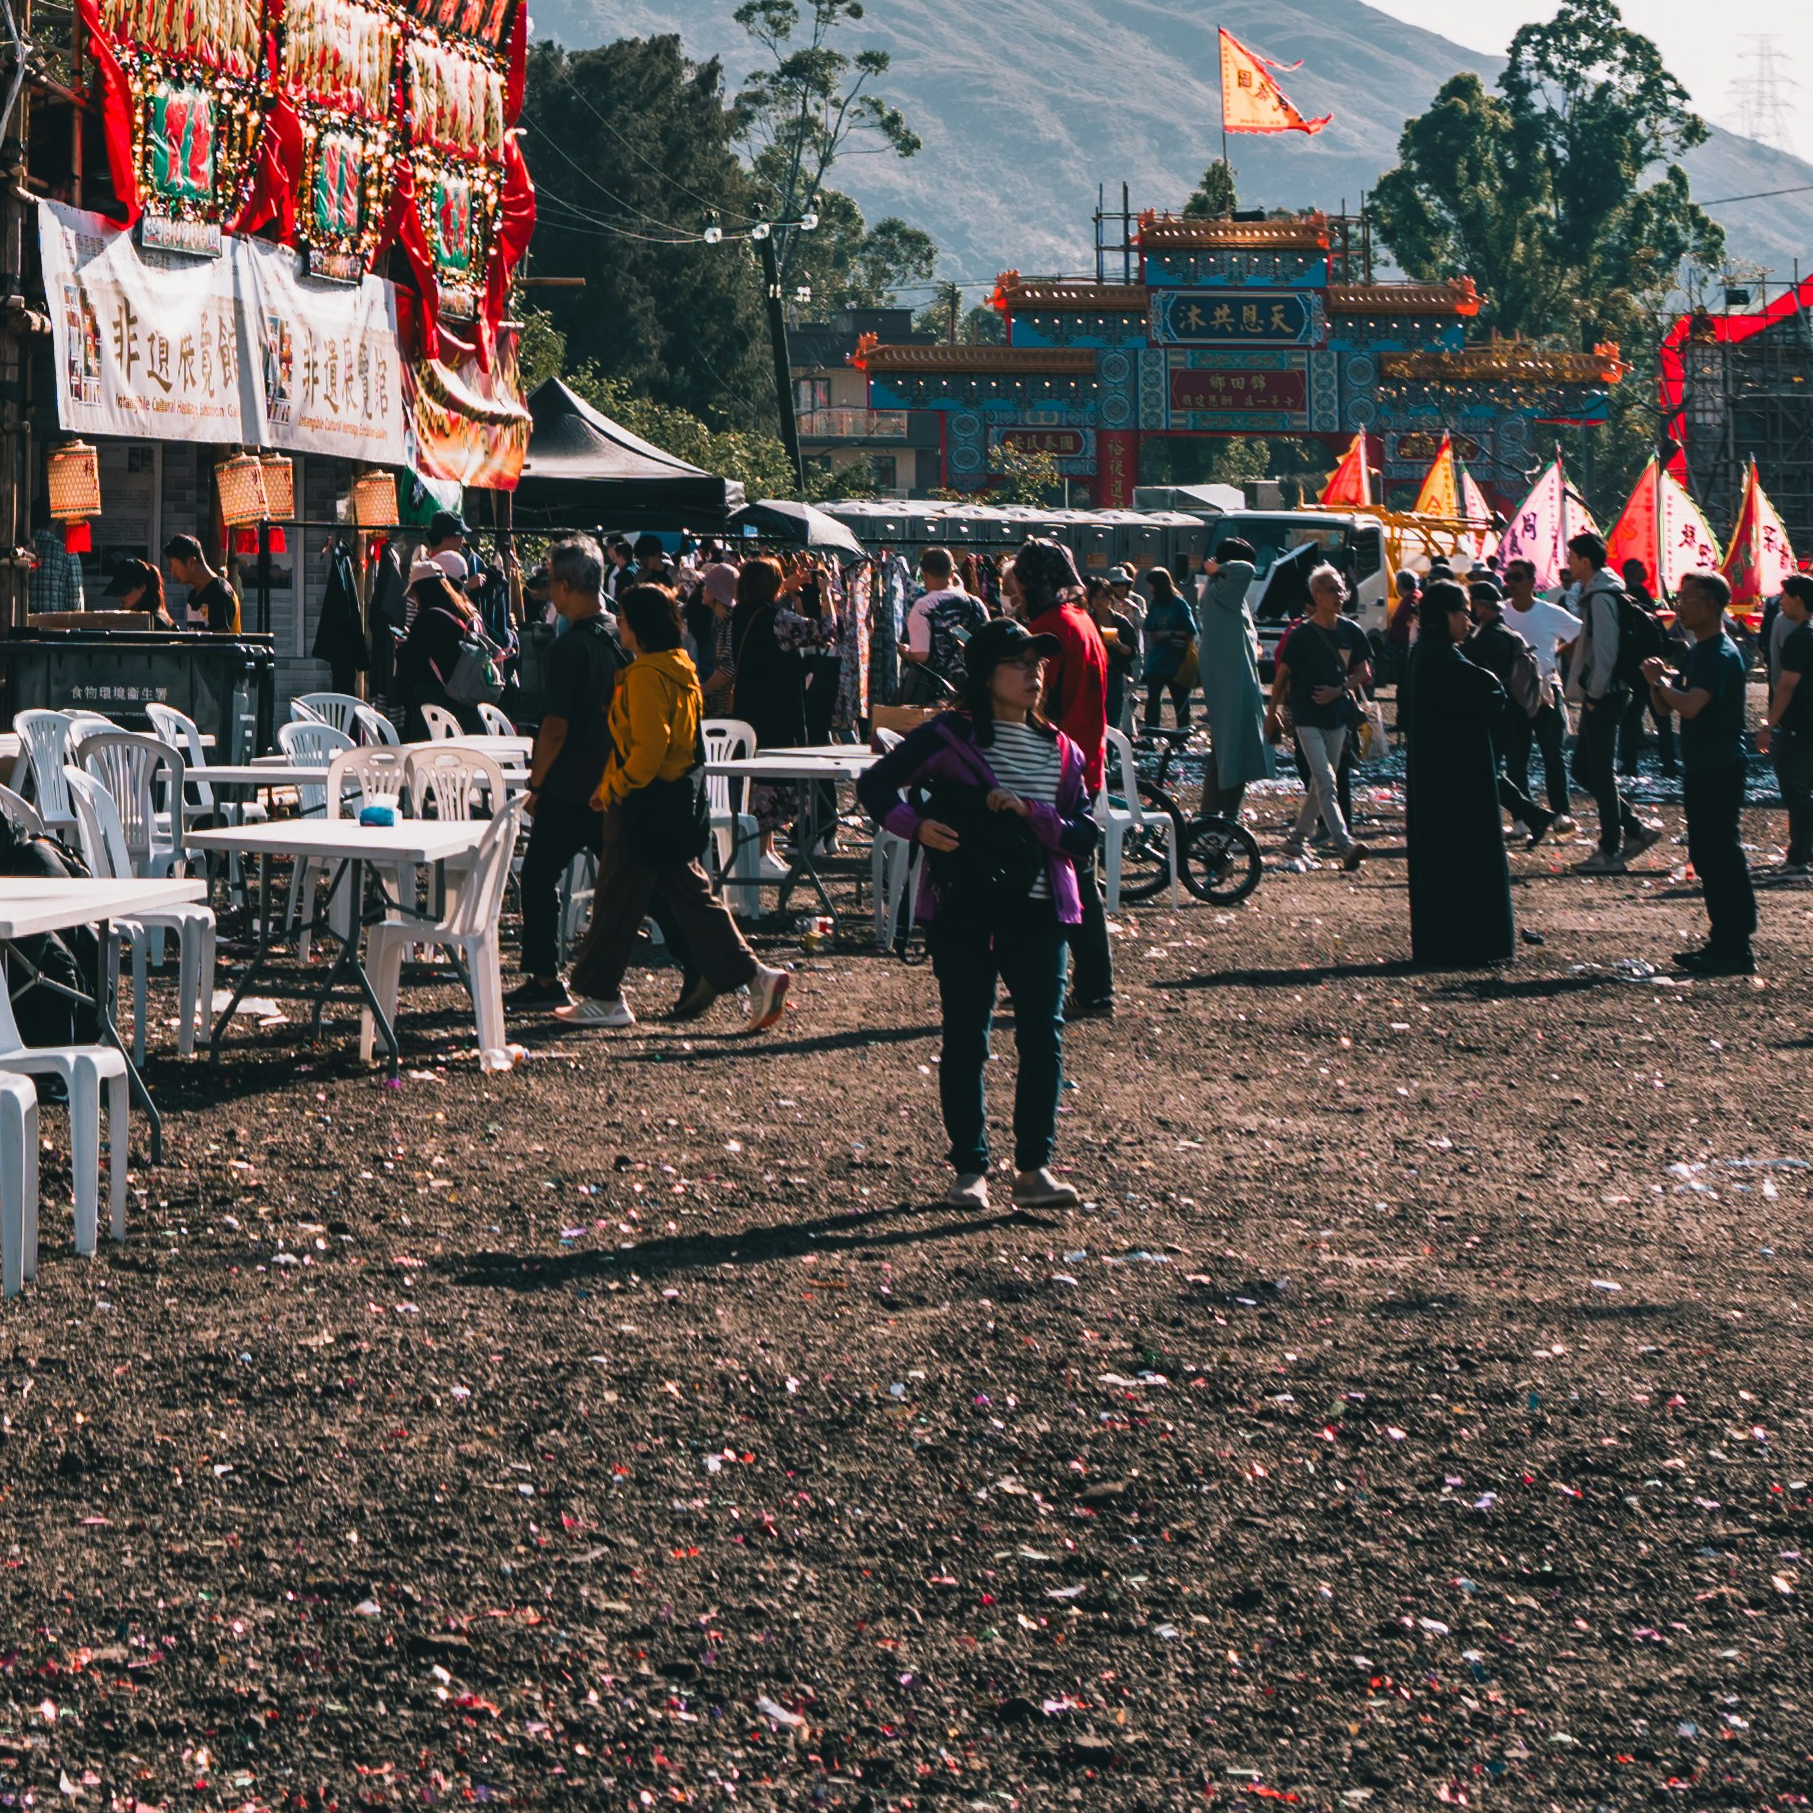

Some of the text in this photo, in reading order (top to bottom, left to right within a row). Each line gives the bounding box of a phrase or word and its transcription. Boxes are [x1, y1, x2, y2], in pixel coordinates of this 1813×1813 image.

[1178, 303, 1295, 334] 天恩共沐
[1209, 373, 1267, 392] 錦田鄉
